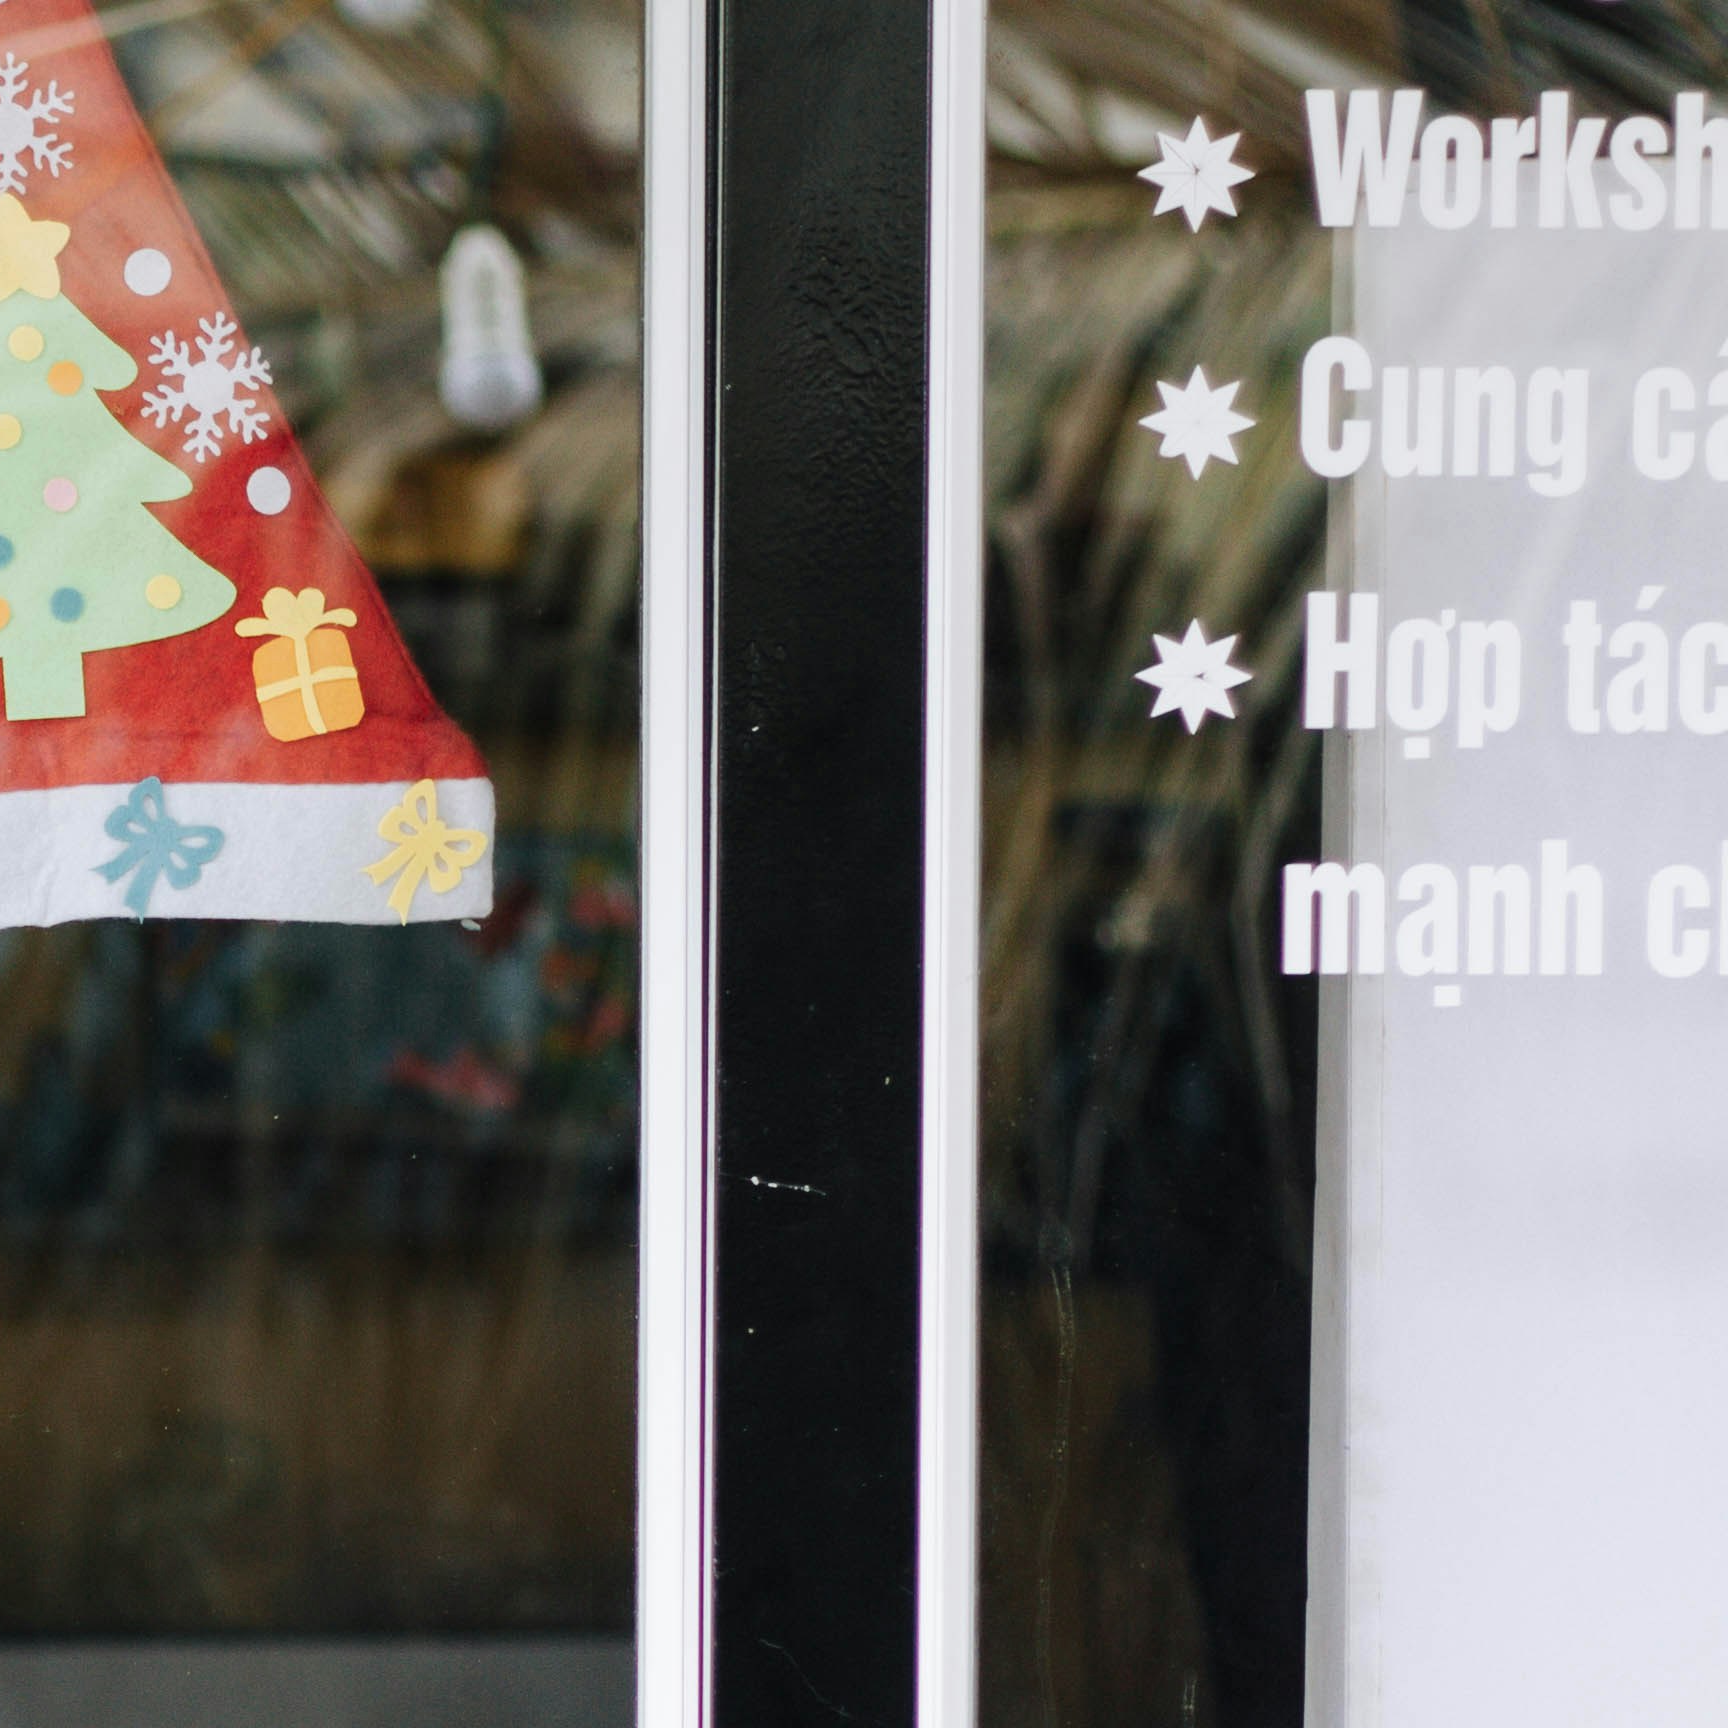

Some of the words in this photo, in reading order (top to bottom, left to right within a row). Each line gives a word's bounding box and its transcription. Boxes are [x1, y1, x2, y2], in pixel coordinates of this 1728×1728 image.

[1305, 89, 1728, 231] Worksh
[1300, 336, 1589, 496] Cung
[1304, 591, 1522, 759] Hợp
[1563, 585, 1728, 735] tác
[1281, 839, 1603, 1007] mạnh
[1646, 839, 1728, 979] c
